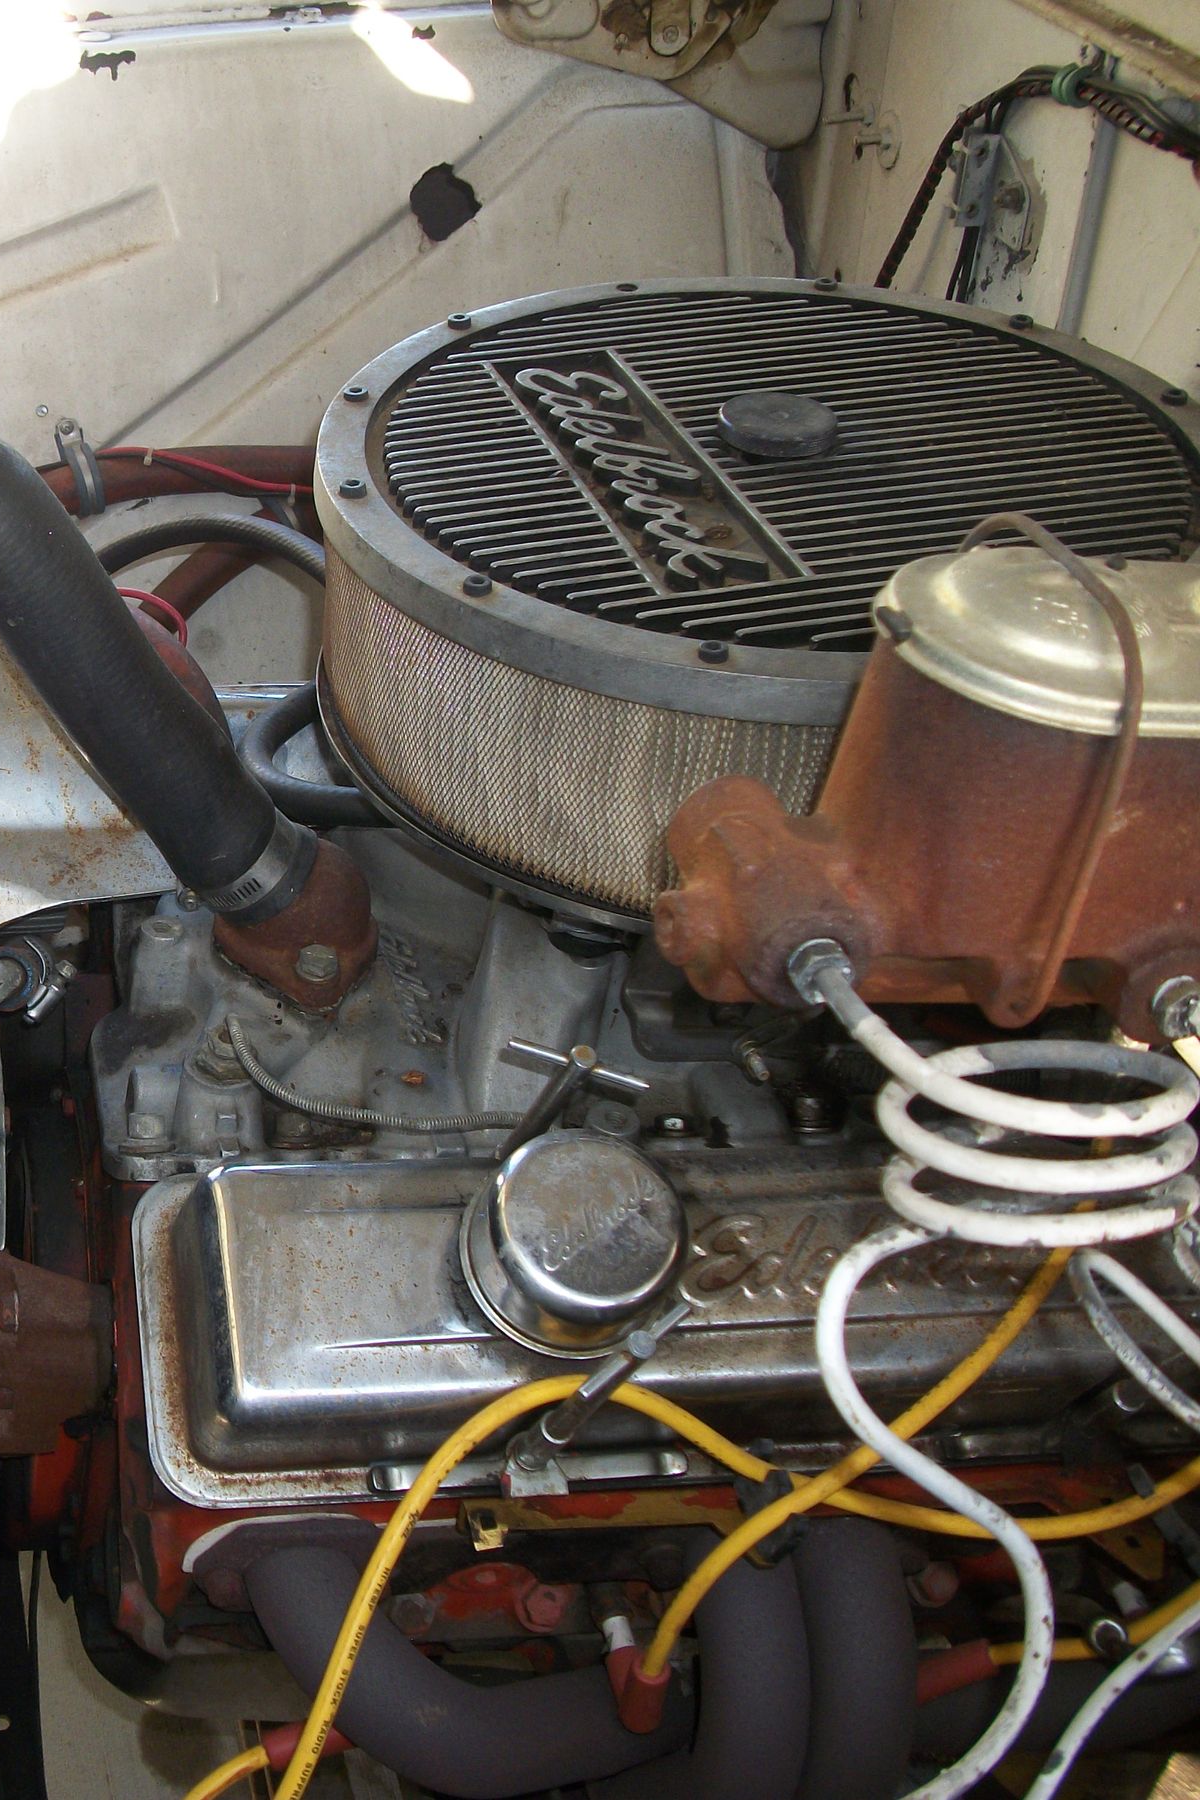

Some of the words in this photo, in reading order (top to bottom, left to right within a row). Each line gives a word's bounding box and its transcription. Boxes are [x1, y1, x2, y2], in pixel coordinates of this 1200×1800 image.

[513, 367, 770, 581] Edelbrock
[347, 1624, 367, 1661] SUPER
[330, 1668, 350, 1707] STOCK
[311, 1719, 332, 1755] RADIO
